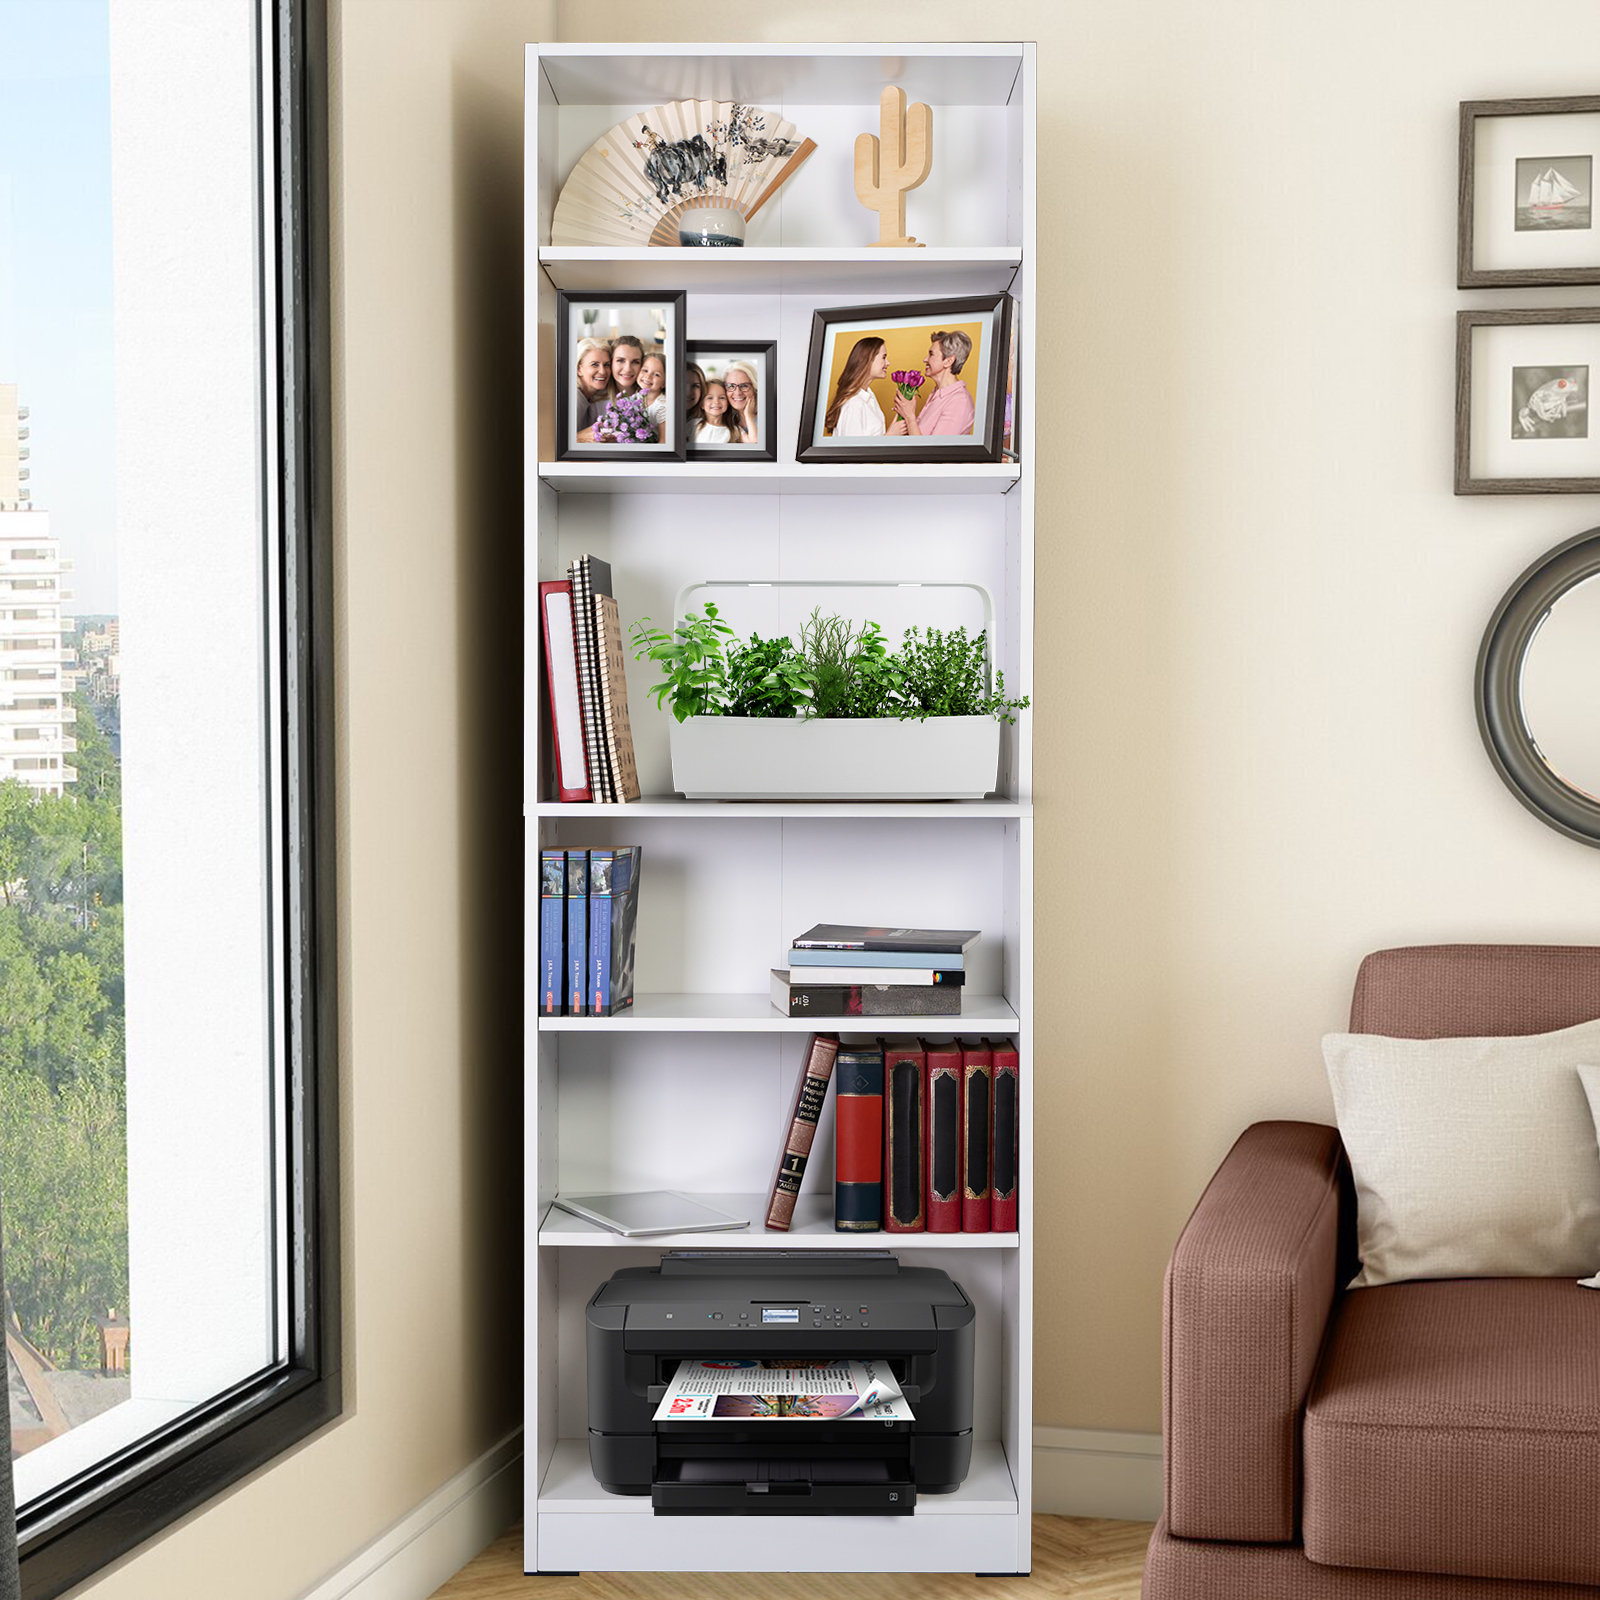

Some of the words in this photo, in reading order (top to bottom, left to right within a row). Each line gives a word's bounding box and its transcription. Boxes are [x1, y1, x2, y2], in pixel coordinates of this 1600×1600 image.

[806, 1079, 820, 1087] Funk
[805, 1095, 818, 1103] New
[791, 1157, 799, 1171] 1
